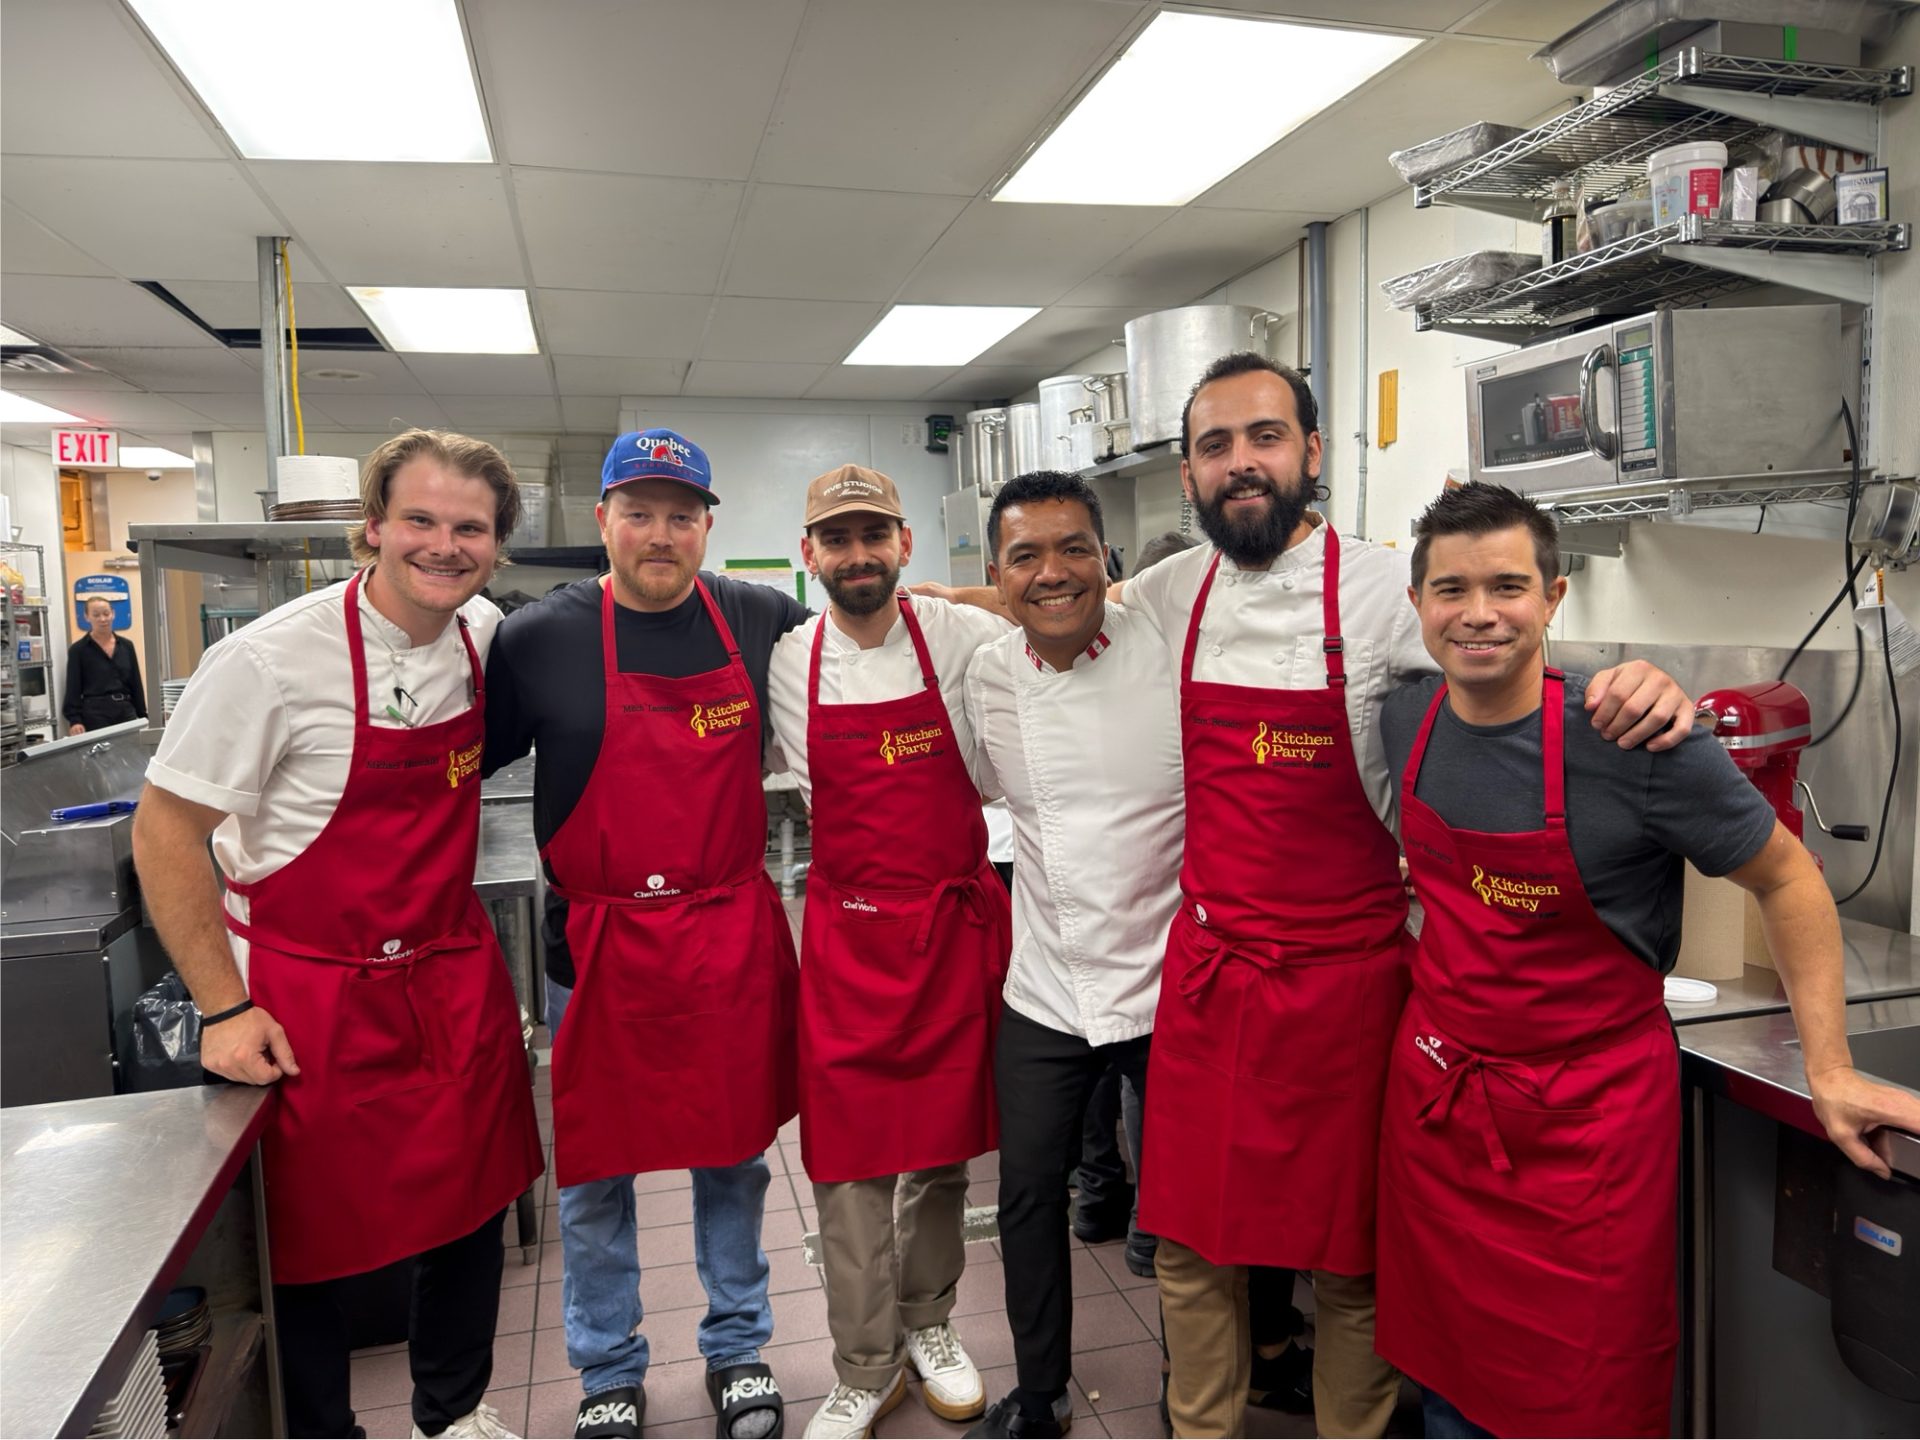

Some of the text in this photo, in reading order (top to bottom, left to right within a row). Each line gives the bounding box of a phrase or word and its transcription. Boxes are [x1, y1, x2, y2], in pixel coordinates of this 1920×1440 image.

[59, 433, 110, 463] EXIT
[636, 437, 691, 457] Quebec
[823, 480, 883, 497] FIVE STUDIOS
[706, 700, 750, 719] Kitchen
[709, 714, 742, 730] Party
[894, 727, 942, 746] Kitchen
[1271, 731, 1334, 746] Kitchen
[897, 741, 932, 757] Party
[1271, 744, 1316, 761] Party
[653, 888, 681, 896] Works
[1488, 875, 1560, 896] Kitchen
[858, 903, 877, 912] Works
[1491, 889, 1539, 912] Party
[1429, 1047, 1447, 1070] Works
[722, 1376, 781, 1410] HOKA
[574, 1402, 637, 1432] HOKA
